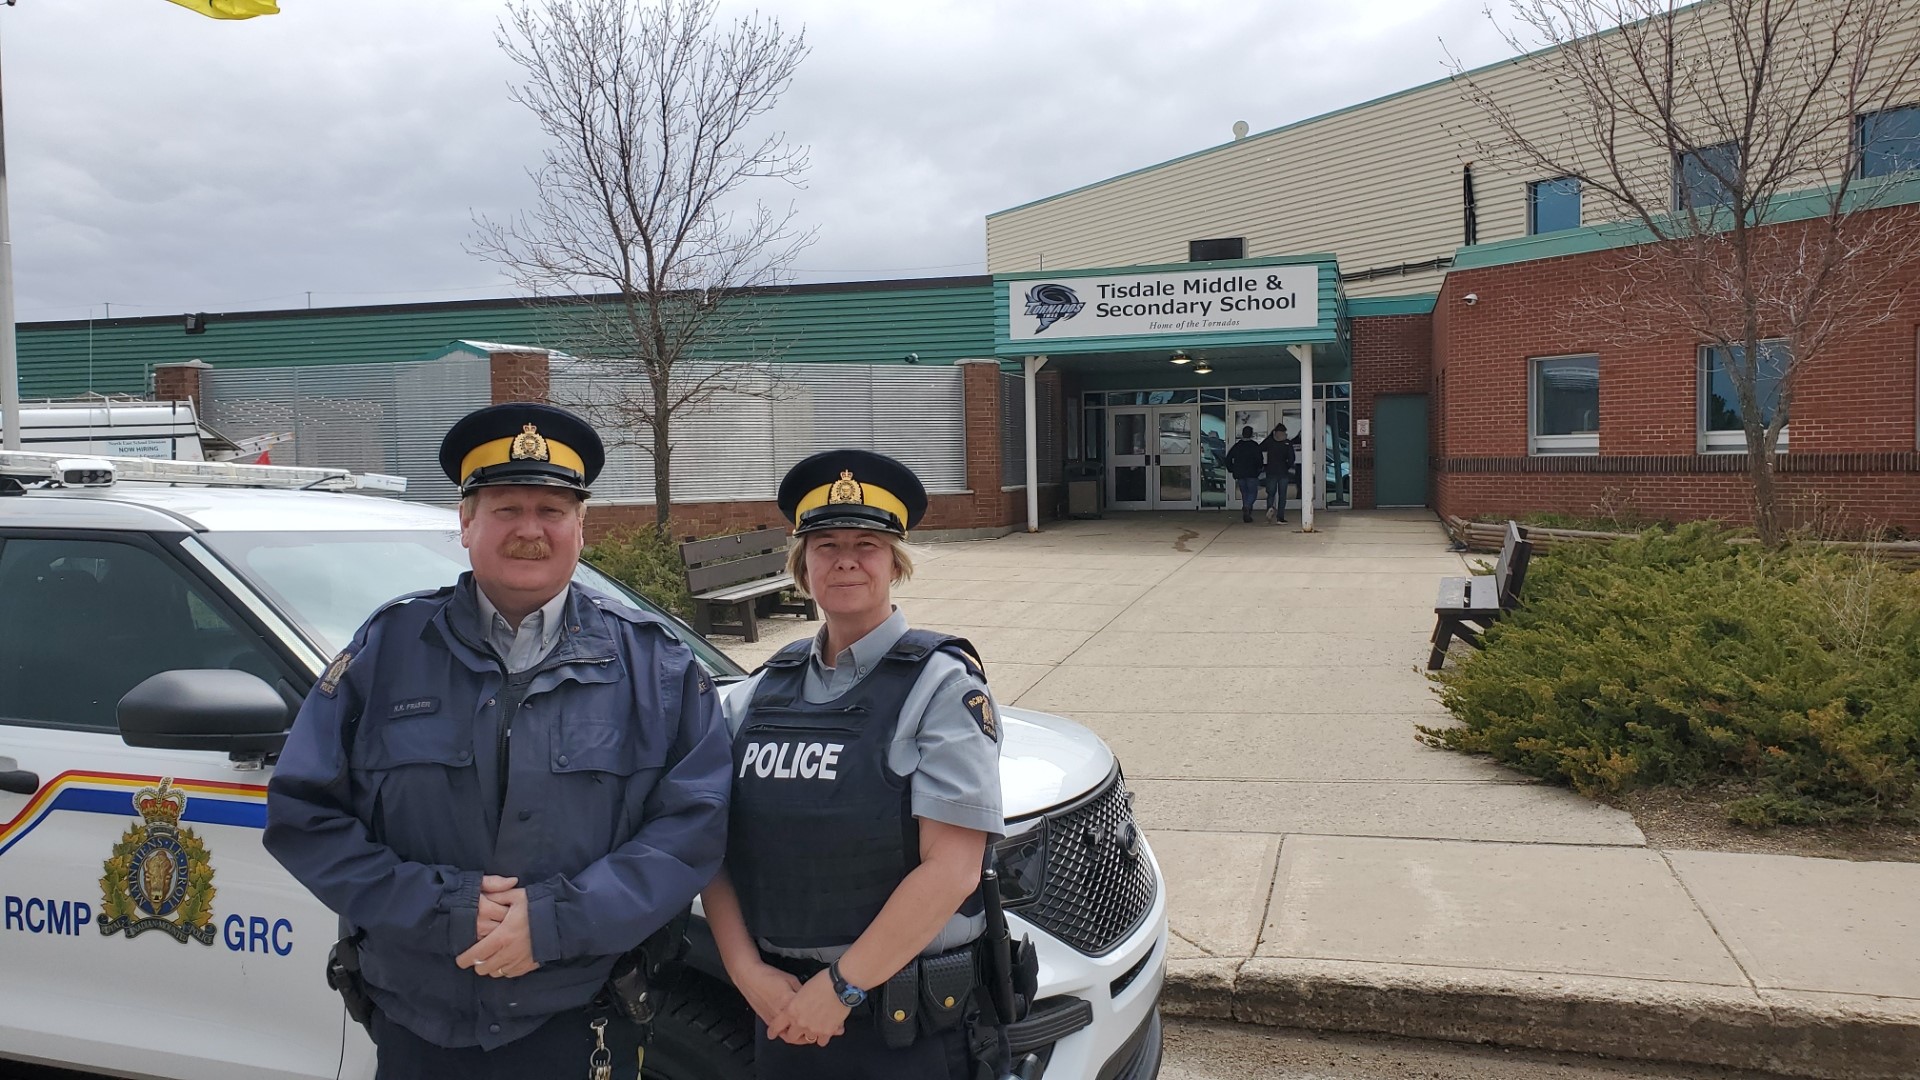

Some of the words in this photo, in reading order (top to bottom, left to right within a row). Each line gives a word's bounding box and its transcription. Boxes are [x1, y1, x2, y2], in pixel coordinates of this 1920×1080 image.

[1096, 281, 1175, 299] Tisdale
[1183, 276, 1257, 295] Middle
[1266, 274, 1283, 291] &
[1024, 302, 1086, 315] TORNADOS
[1096, 299, 1213, 317] Secondary
[1220, 292, 1296, 312] School
[1149, 321, 1173, 330] Home
[1175, 320, 1186, 330] of
[1186, 319, 1200, 329] the
[1202, 318, 1240, 328] Tornados
[739, 742, 844, 780] POLICE
[5, 896, 91, 936] RCMP
[223, 914, 293, 956] GRC
[190, 923, 213, 943] POLICE
